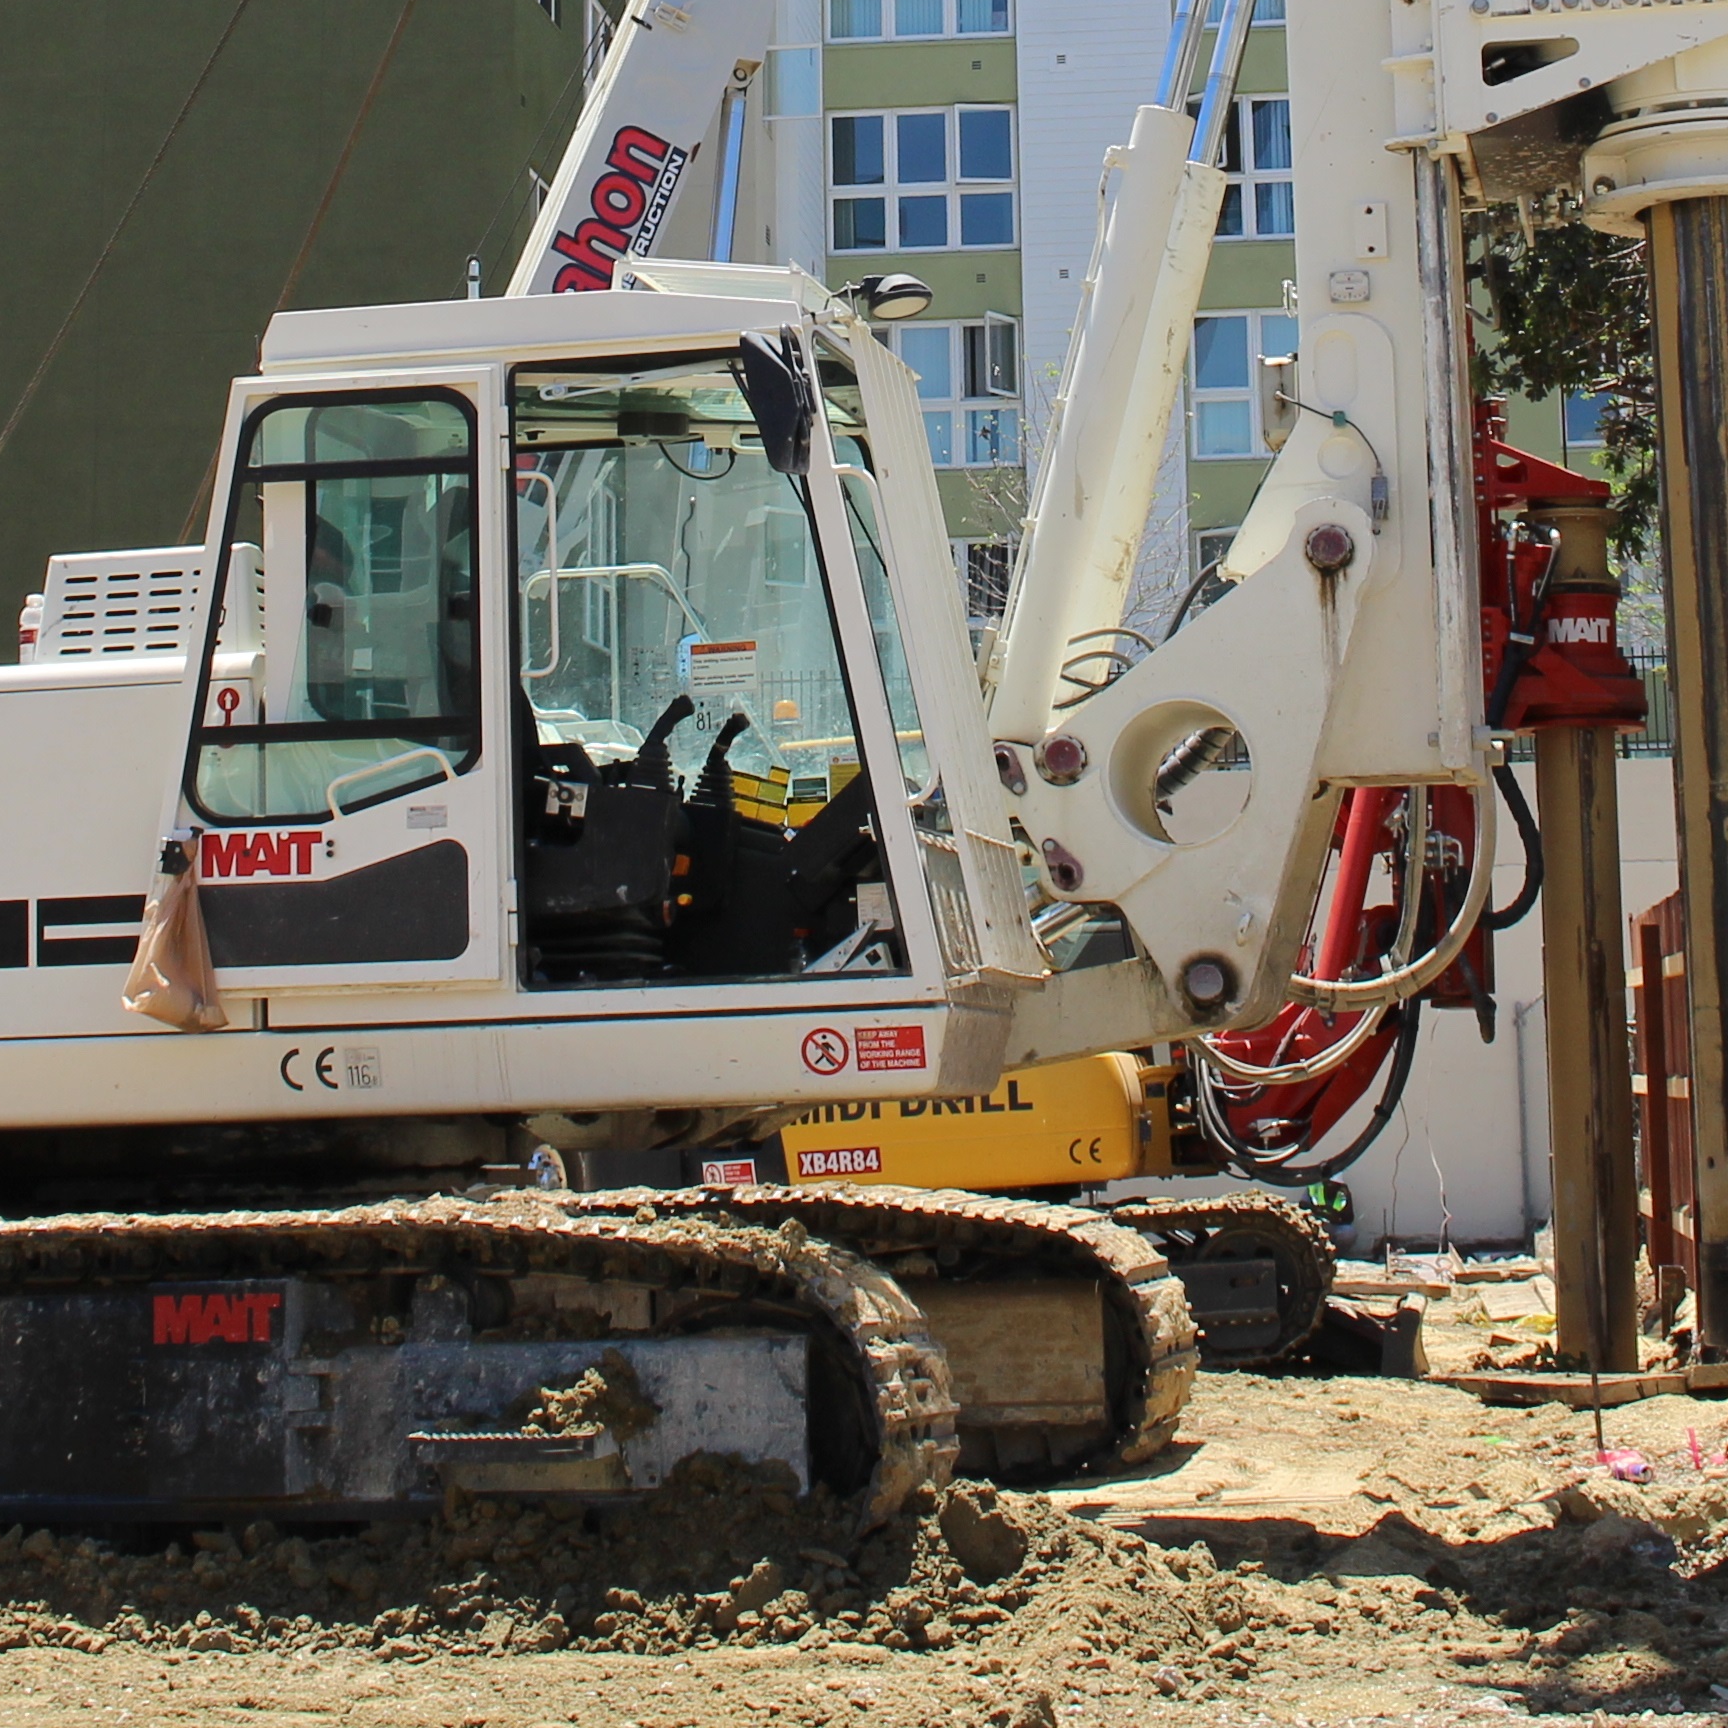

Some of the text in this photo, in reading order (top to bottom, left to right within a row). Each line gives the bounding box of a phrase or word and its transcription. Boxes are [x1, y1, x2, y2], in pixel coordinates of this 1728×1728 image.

[552, 125, 670, 291] ahon
[696, 712, 712, 731] 81
[858, 1030, 898, 1039] KEEP AWAY
[880, 1040, 896, 1048] THE
[859, 1049, 921, 1059] WORKING RANGE
[860, 1058, 921, 1069] OF THE MACHINE
[348, 1065, 371, 1086] 116
[900, 1080, 1034, 1117] DRILL
[800, 1148, 880, 1176] XB4R84
